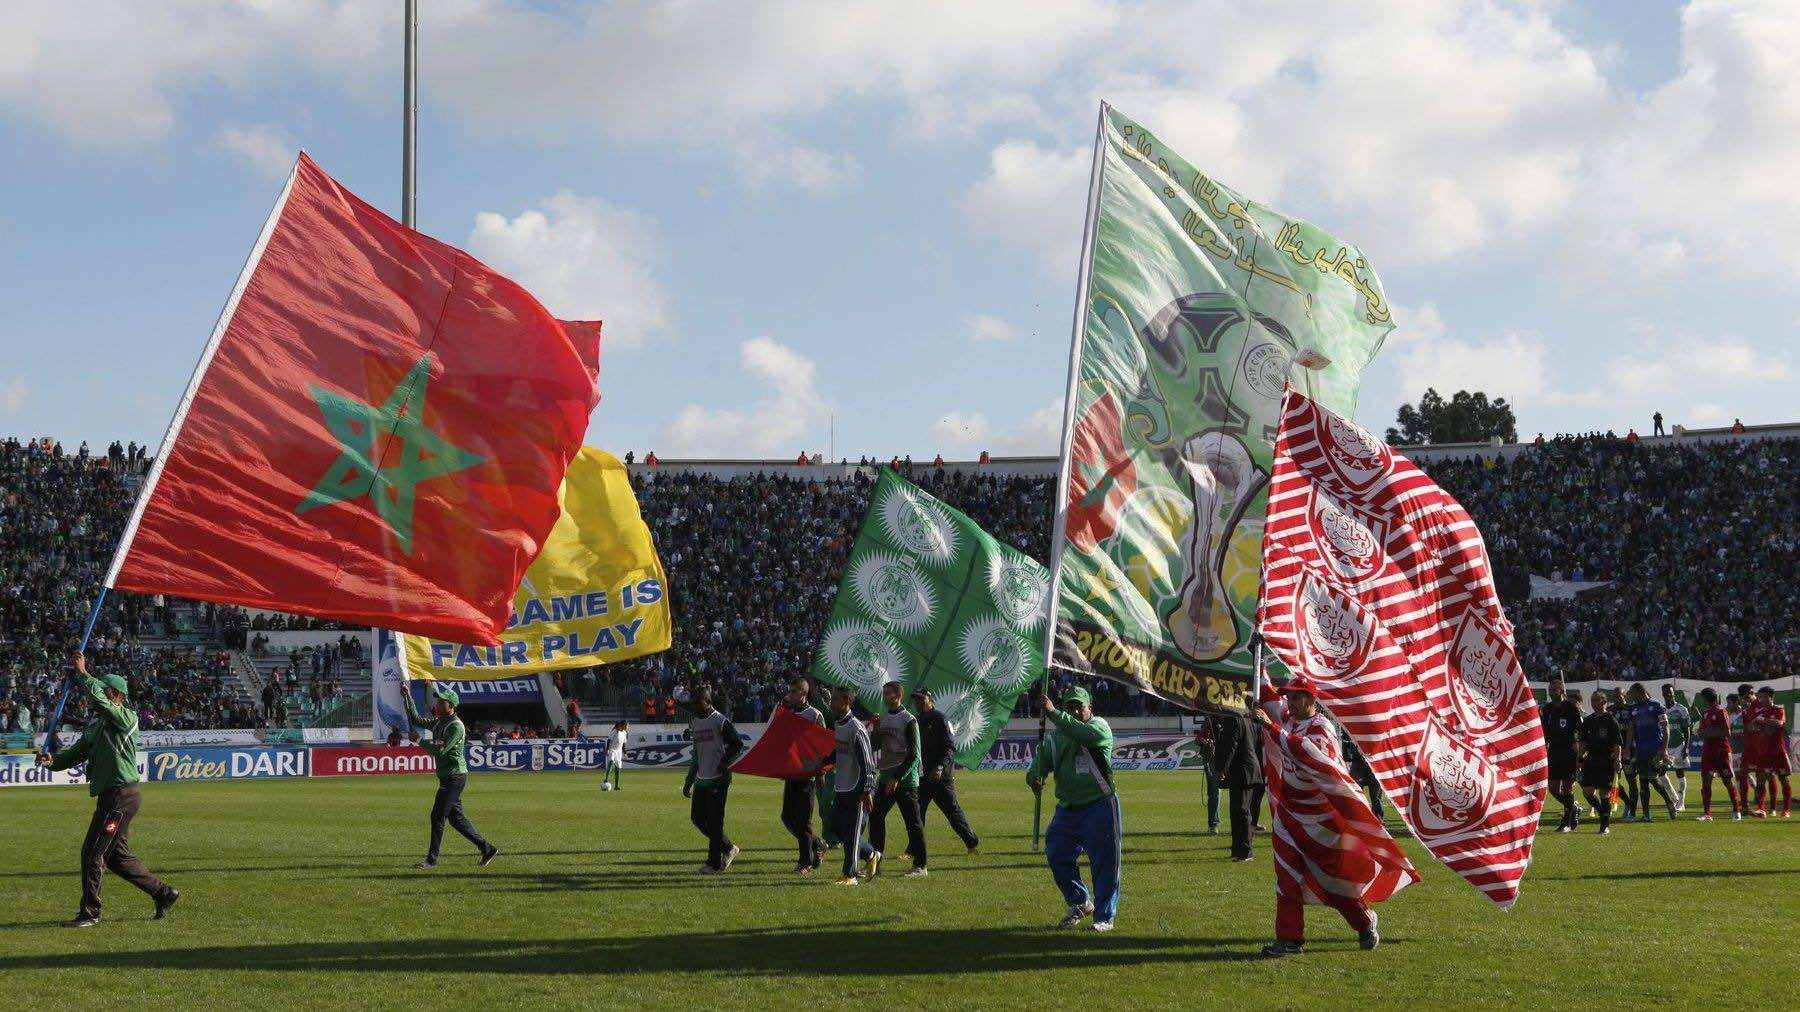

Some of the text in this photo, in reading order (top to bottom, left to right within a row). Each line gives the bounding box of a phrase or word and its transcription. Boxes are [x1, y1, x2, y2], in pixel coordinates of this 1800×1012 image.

[622, 578, 664, 610] IS
[430, 617, 645, 669] FAIR PLAY
[433, 679, 539, 693] YUNDAI
[154, 752, 226, 781] Pâtes
[231, 751, 305, 778] DARI
[469, 744, 523, 768] Star
[547, 744, 600, 767] Star
